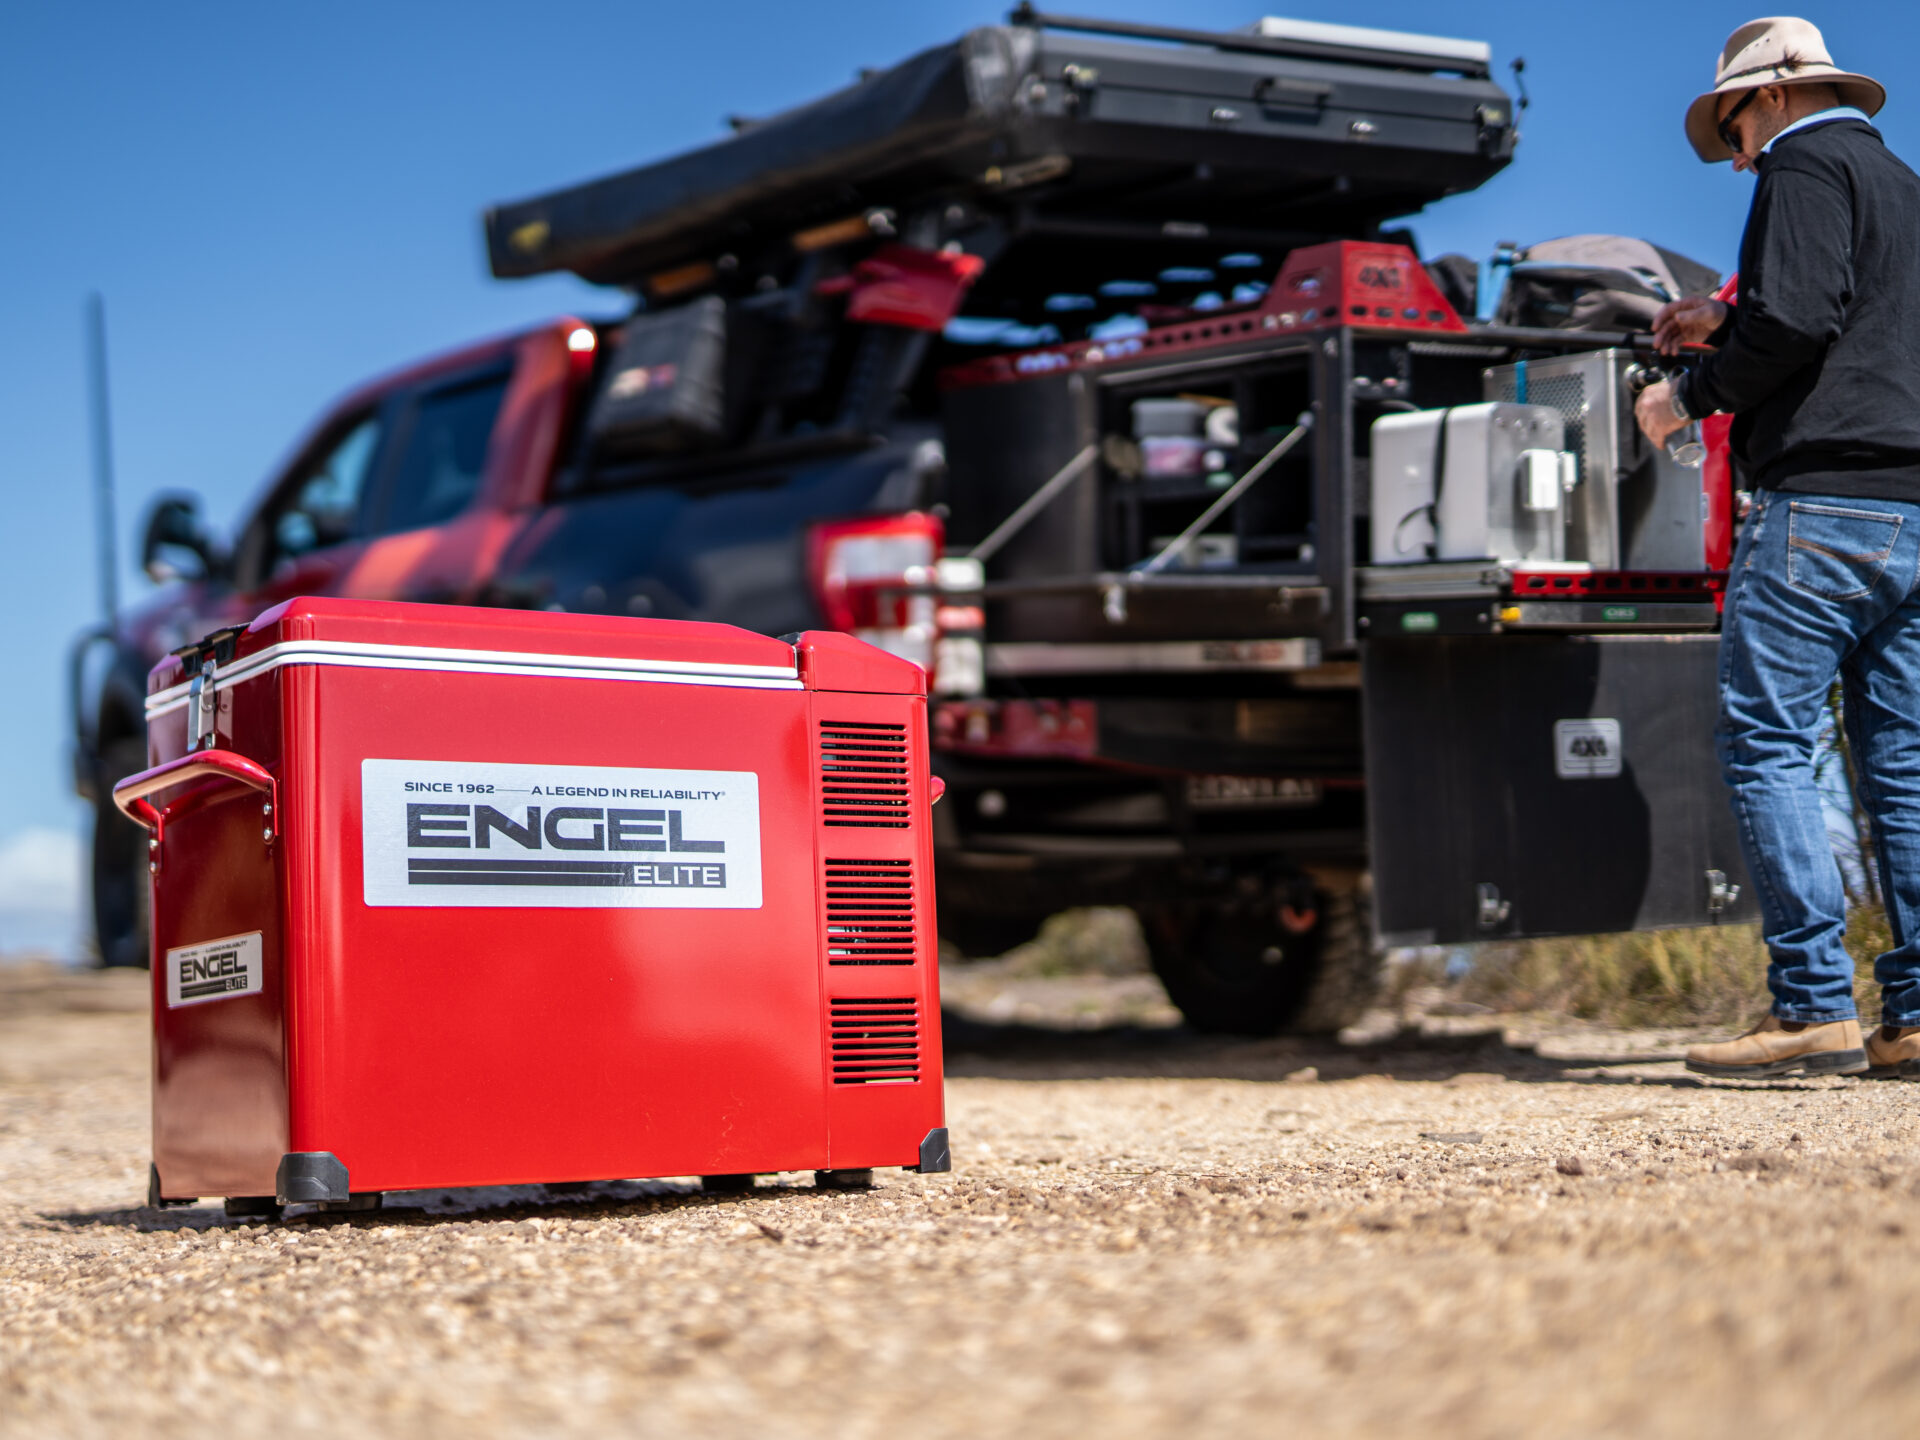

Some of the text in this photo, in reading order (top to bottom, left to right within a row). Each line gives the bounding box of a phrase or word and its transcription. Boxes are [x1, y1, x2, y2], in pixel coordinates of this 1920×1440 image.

[404, 781, 721, 801] SINCE 1962 A LEGEND IN RELIABILITY
[406, 802, 725, 854] ENGEL
[633, 865, 721, 885] ELITE
[180, 950, 248, 984] ENGEL
[225, 976, 247, 991] ELITE
